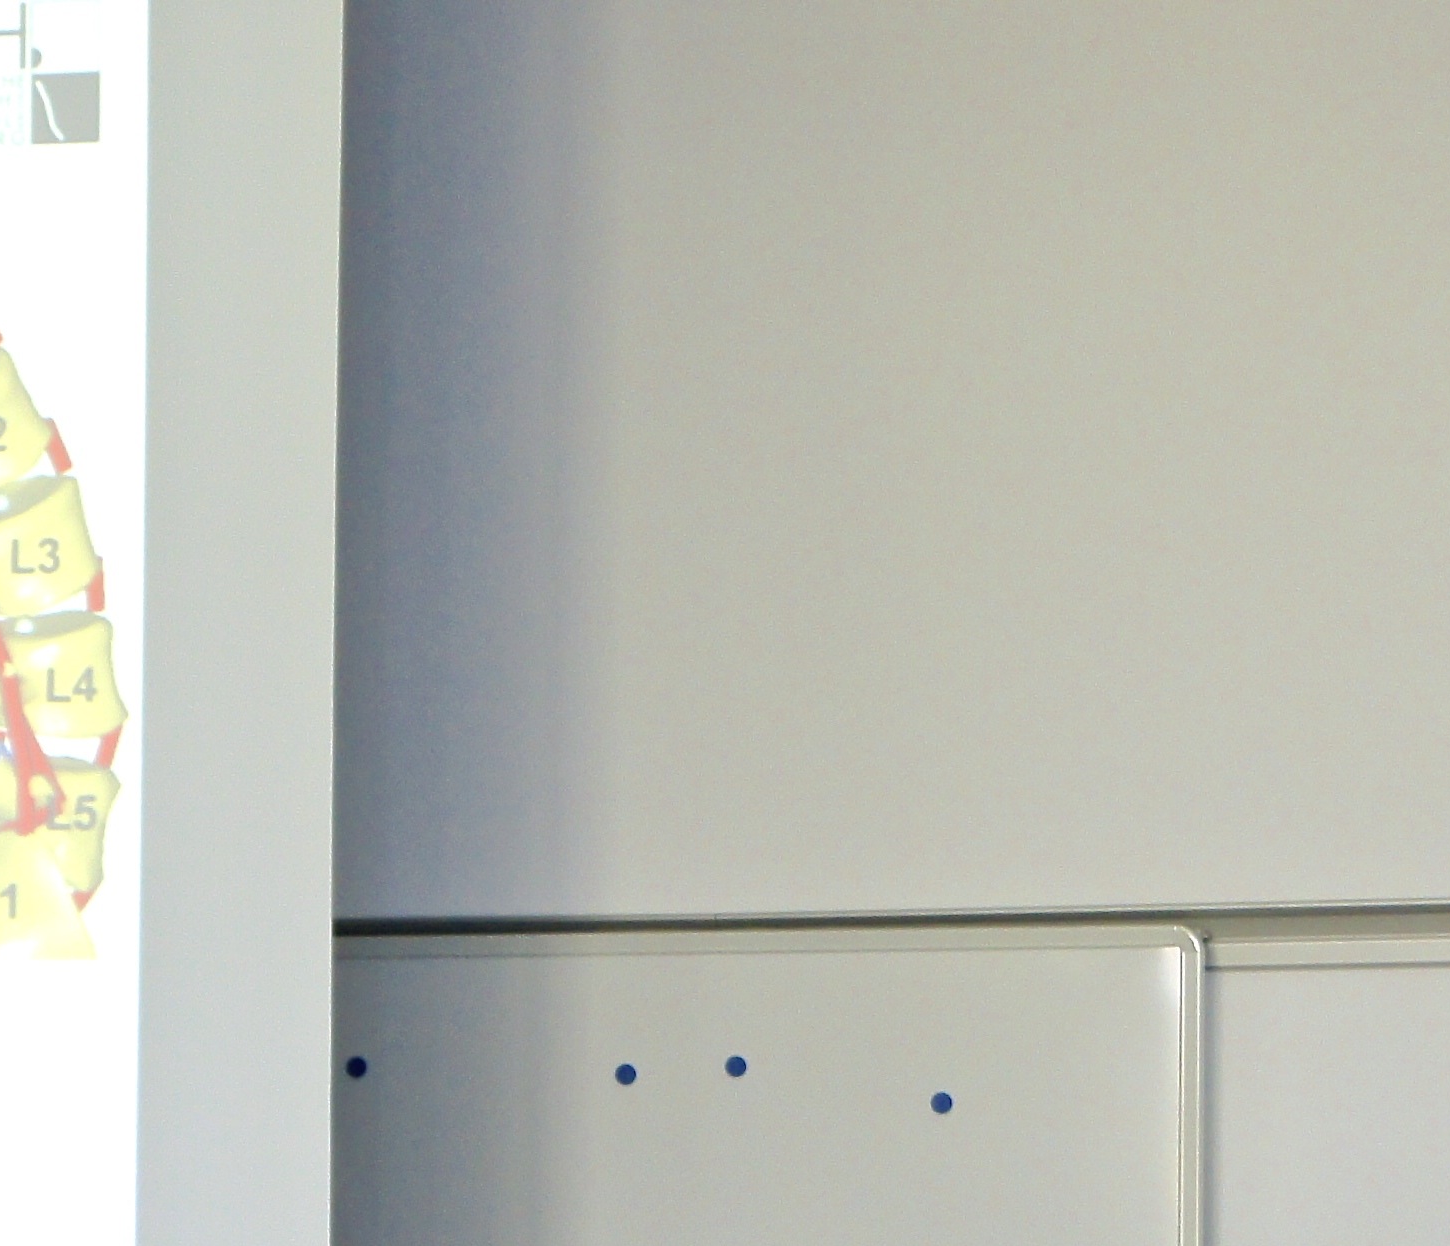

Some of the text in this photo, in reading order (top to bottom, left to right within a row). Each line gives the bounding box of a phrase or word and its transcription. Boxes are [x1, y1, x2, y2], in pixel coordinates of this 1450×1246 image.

[10, 538, 61, 575] L3
[46, 666, 98, 703] L4
[46, 793, 98, 831] L5
